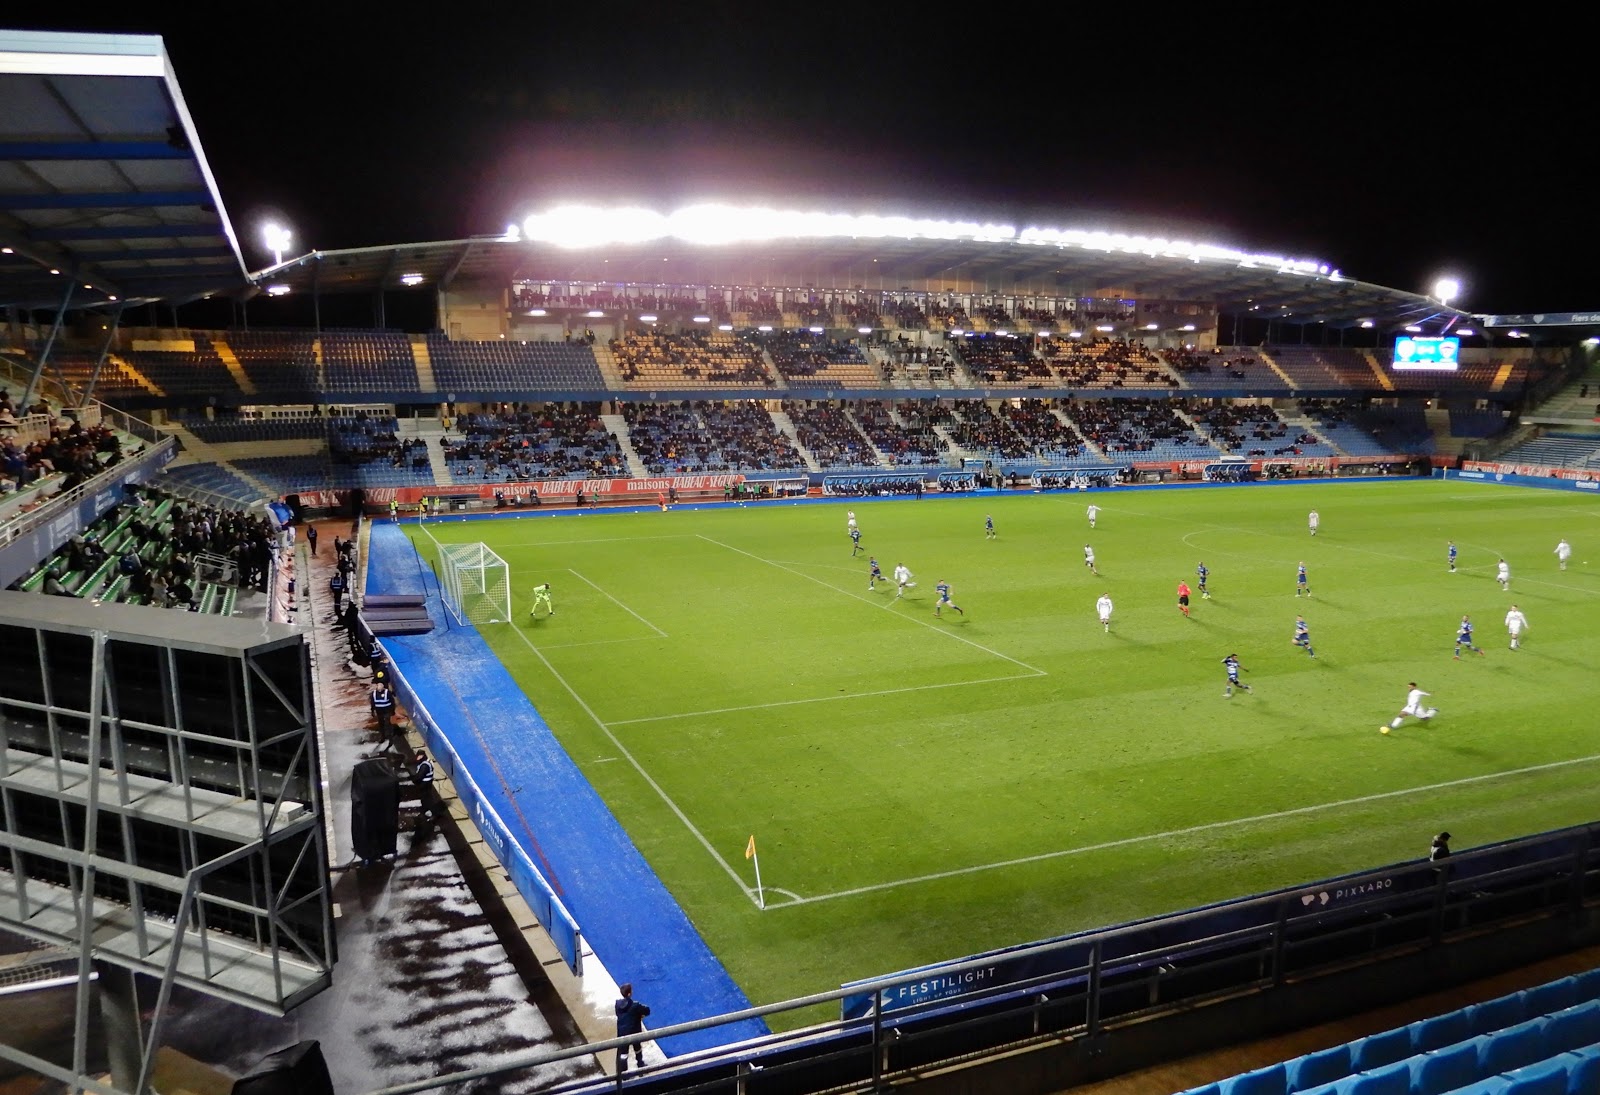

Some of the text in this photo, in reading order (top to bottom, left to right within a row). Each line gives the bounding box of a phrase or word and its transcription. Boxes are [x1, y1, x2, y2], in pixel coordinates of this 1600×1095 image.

[1571, 314, 1588, 322] Fiers
[492, 482, 539, 497] maisons
[627, 479, 669, 491] maisons
[1336, 878, 1392, 899] PIXXARO
[899, 967, 996, 998] FESTILIGHT
[912, 995, 932, 1004] LIGHT
[945, 988, 961, 996] YOUR
